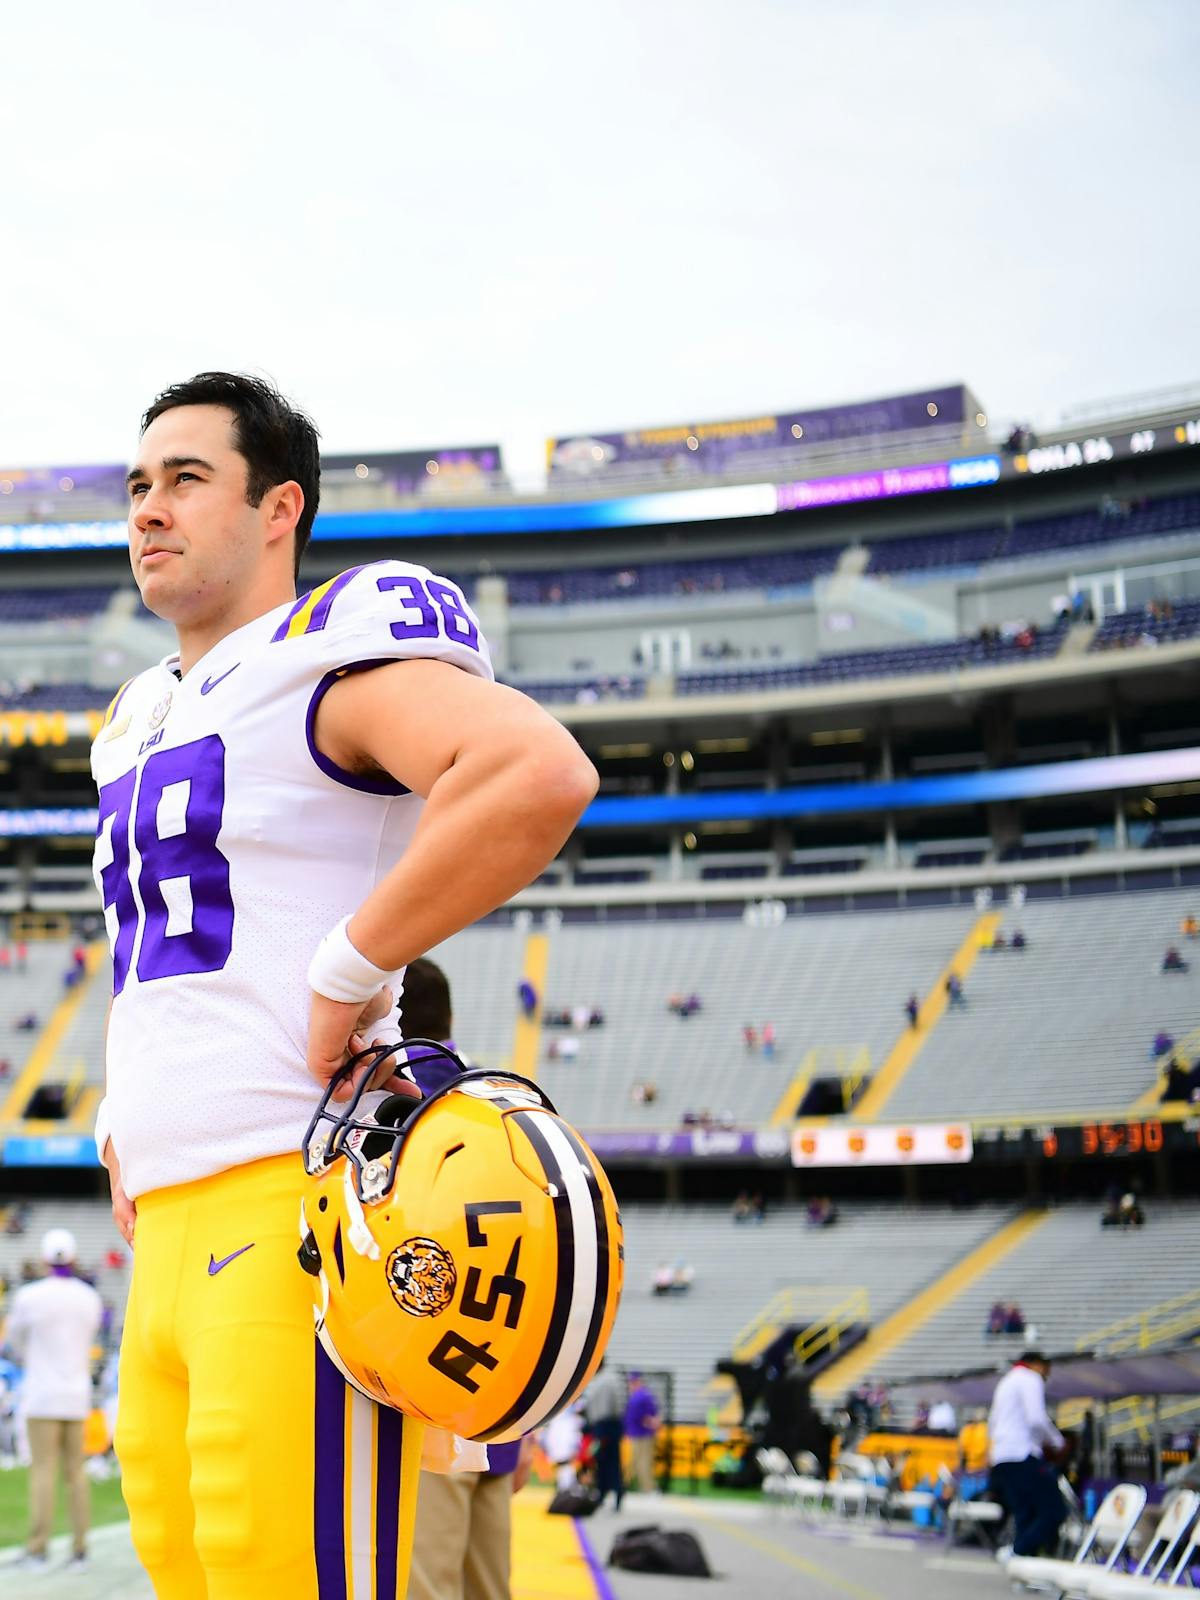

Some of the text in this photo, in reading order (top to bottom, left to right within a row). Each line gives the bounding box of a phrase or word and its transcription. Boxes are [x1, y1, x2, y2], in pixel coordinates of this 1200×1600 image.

[376, 576, 479, 652] 38
[138, 728, 165, 756] LSU
[428, 1201, 527, 1394] LSU
